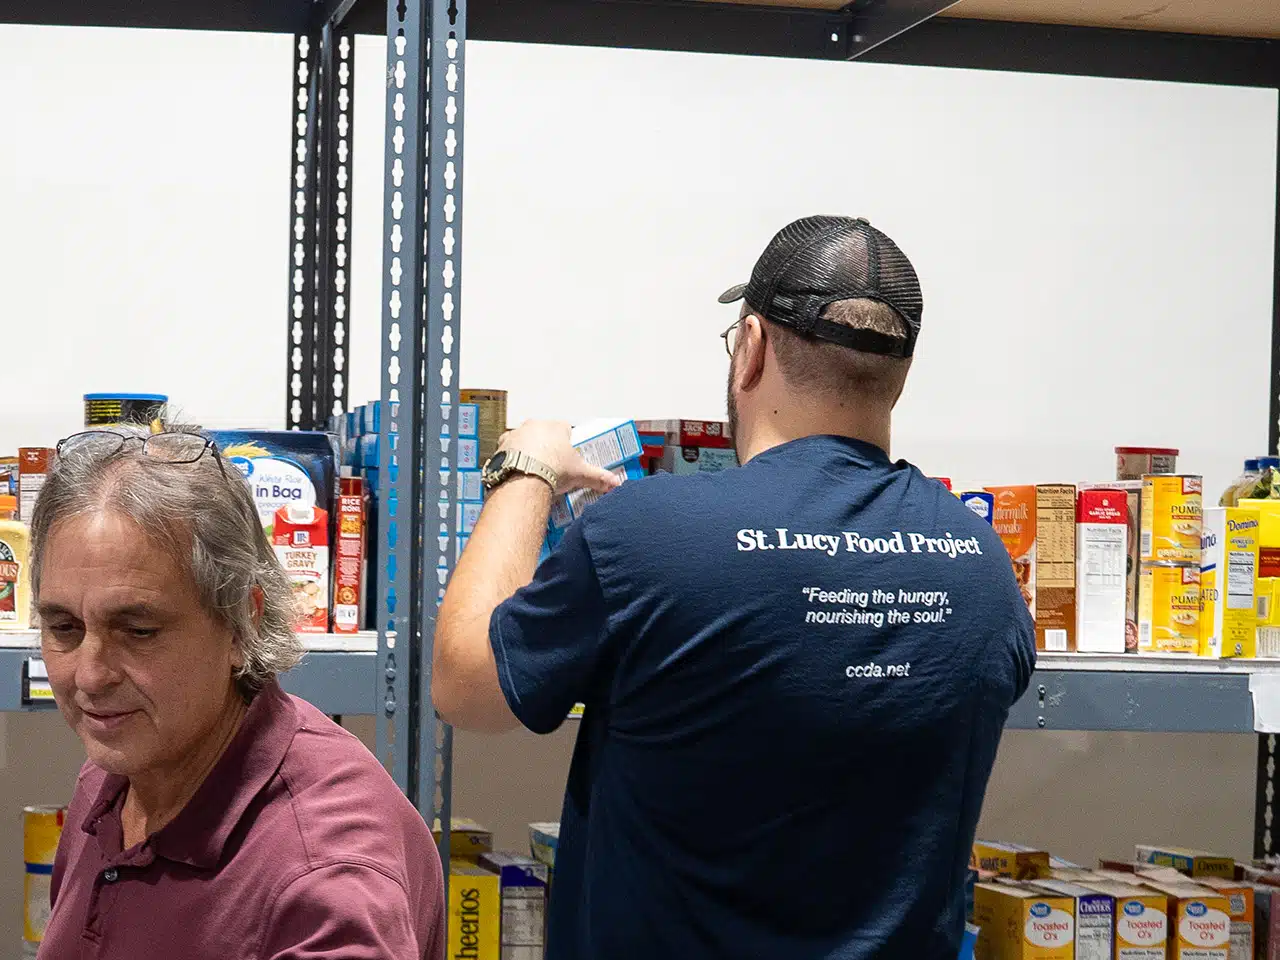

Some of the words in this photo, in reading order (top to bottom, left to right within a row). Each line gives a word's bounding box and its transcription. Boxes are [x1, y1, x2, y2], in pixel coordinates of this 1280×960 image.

[256, 485, 269, 498] in
[272, 485, 302, 500] Bag
[341, 498, 361, 506] RICE
[1171, 505, 1202, 514] PUMP
[1227, 519, 1259, 532] Domino
[736, 528, 775, 551] St.
[776, 528, 840, 556] Lucy
[842, 531, 907, 554] Food
[907, 532, 983, 558] Project
[284, 551, 318, 561] TURKEY
[287, 559, 316, 568] GRAVY
[802, 587, 869, 608] "Feeding
[871, 589, 895, 604] the
[898, 588, 949, 606] hungry,
[1171, 595, 1201, 604] PUMP
[805, 608, 884, 627] nourishing
[887, 609, 910, 624] the
[913, 608, 952, 624] soul."
[846, 662, 911, 678] ccda.net
[1032, 921, 1069, 931] Toasted
[1126, 920, 1163, 929] Toasted
[1189, 921, 1225, 930] Toasted
